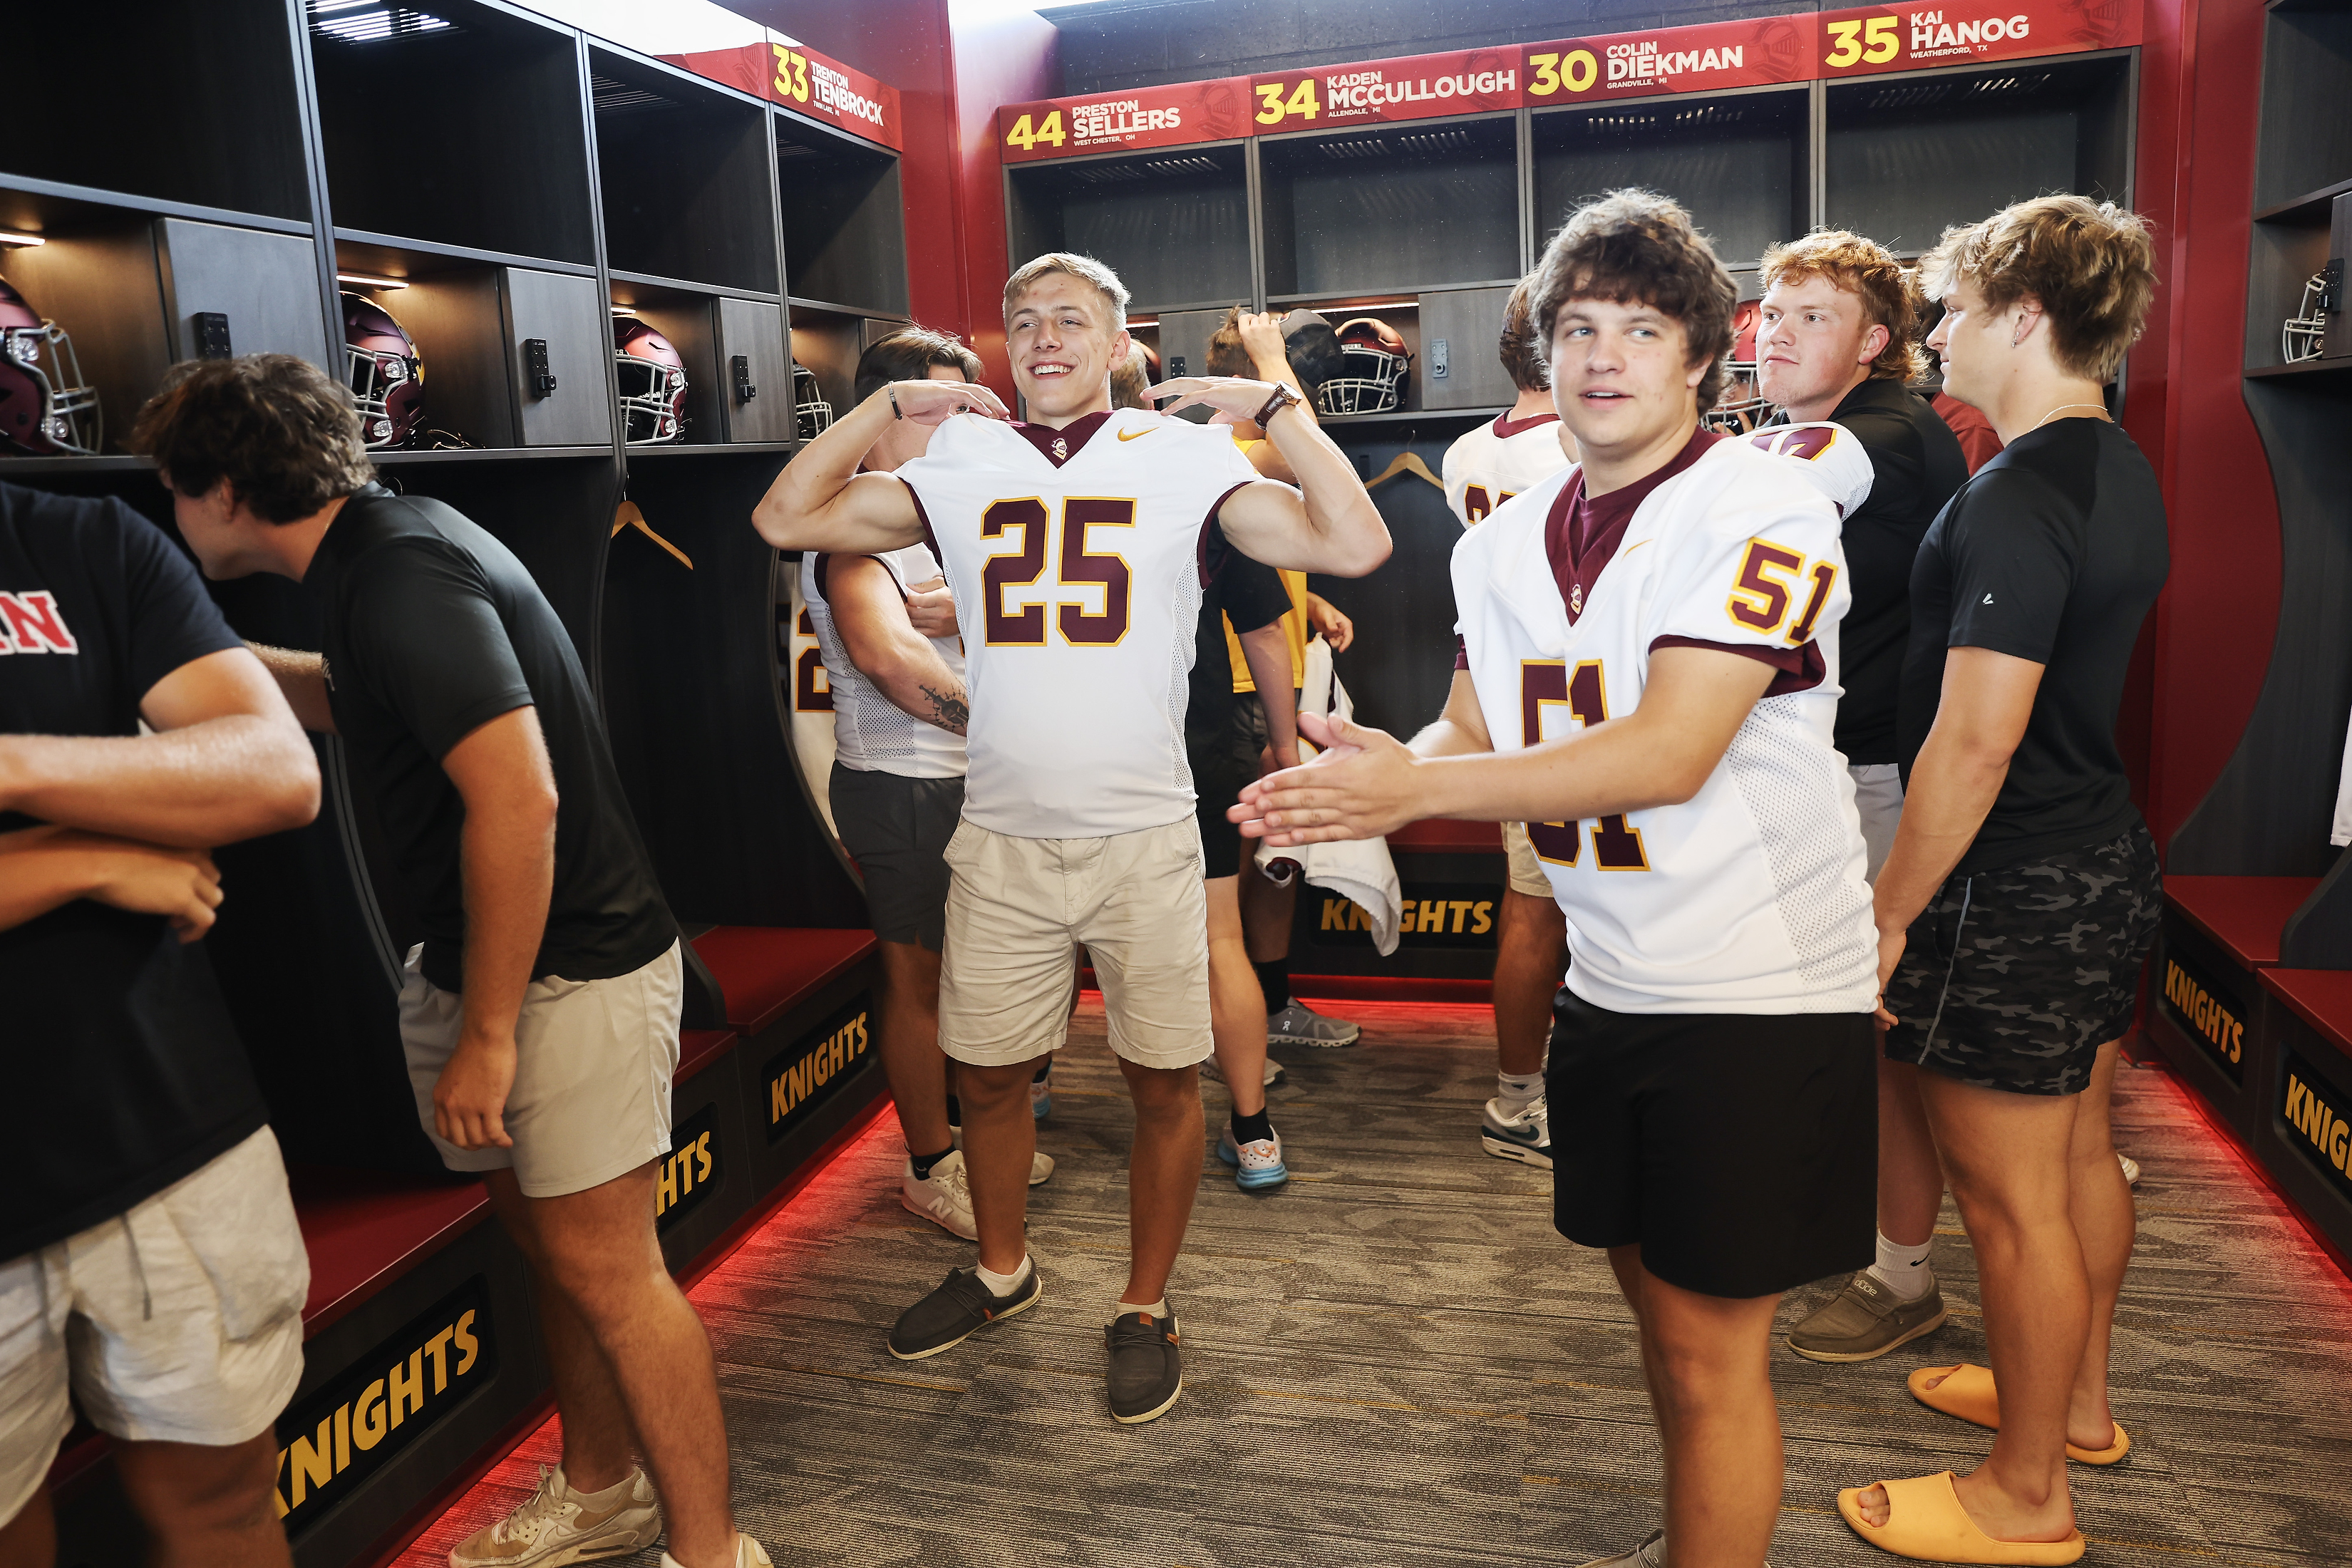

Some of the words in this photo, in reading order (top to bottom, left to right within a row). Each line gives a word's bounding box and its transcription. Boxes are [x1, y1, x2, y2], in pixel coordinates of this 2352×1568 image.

[1910, 10, 1943, 27] KAI
[1911, 14, 2029, 51] HANOG
[1606, 41, 1658, 58] COLIN
[1824, 15, 1900, 68] 35
[1909, 46, 1972, 59] WEATHERFORD,
[773, 43, 809, 103] 33
[810, 60, 849, 90] TRENTON
[1327, 71, 1383, 89] KADEN
[1527, 49, 1599, 96] 30
[1606, 45, 1743, 81] DIEKMAN
[811, 75, 884, 127] TENBROCK
[1254, 78, 1320, 125] 34
[1328, 69, 1515, 110] MCCULLOUGH
[1606, 79, 1654, 90] GRANDVILLE,
[813, 100, 823, 110] TWIN
[1072, 99, 1139, 119] PRESTON
[1073, 107, 1181, 139] SELLERS
[1328, 108, 1368, 118] ALLENDALE,
[1006, 110, 1066, 150] 44
[1073, 138, 1091, 147] WEST
[1092, 135, 1122, 145] CHESTER,
[980, 495, 1138, 646] 25
[1725, 537, 1839, 646] 51
[0, 590, 79, 655] N
[1520, 659, 1651, 872] 51
[1321, 899, 1492, 934] KNGHTS
[2165, 959, 2244, 1063] KNIGHTS
[771, 1011, 868, 1125] KNIGHTS
[2285, 1073, 2352, 1181] KNIG
